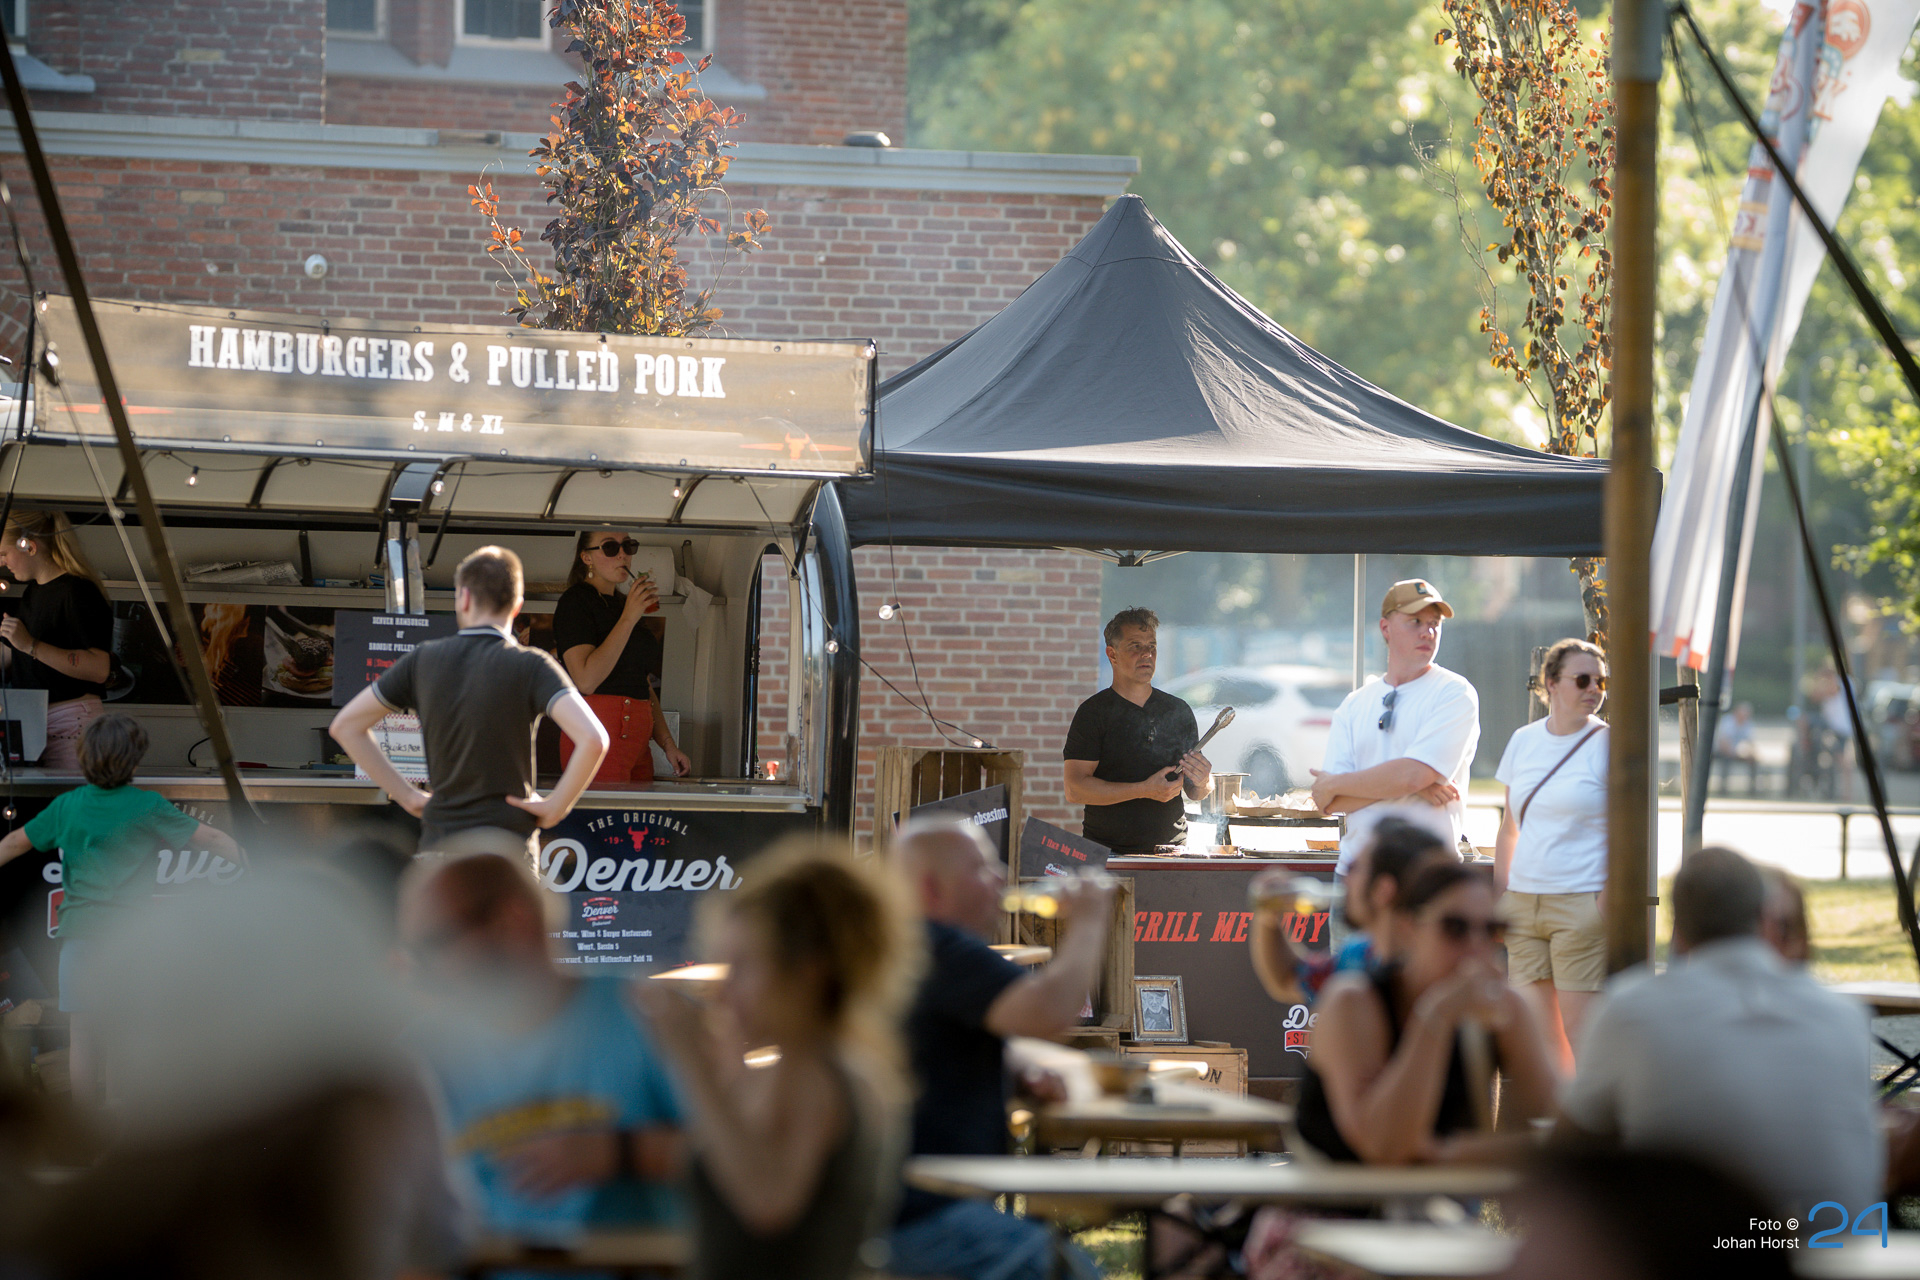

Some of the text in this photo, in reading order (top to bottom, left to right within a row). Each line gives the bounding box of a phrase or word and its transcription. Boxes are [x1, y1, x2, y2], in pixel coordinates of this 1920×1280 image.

[188, 325, 727, 399] HAMBURGERS & PULLED PORK
[436, 412, 456, 432] M
[460, 413, 473, 432] &
[479, 414, 504, 435] XL
[587, 812, 689, 836] THE ORIGINAL
[973, 807, 1009, 826] obsesion
[1046, 838, 1060, 851] like
[1071, 848, 1088, 862] buns
[540, 837, 743, 893] Denver
[581, 905, 619, 918] Denver
[622, 929, 653, 938] Restaurants
[1134, 911, 1203, 943] GRILL
[1209, 912, 1255, 943] ME
